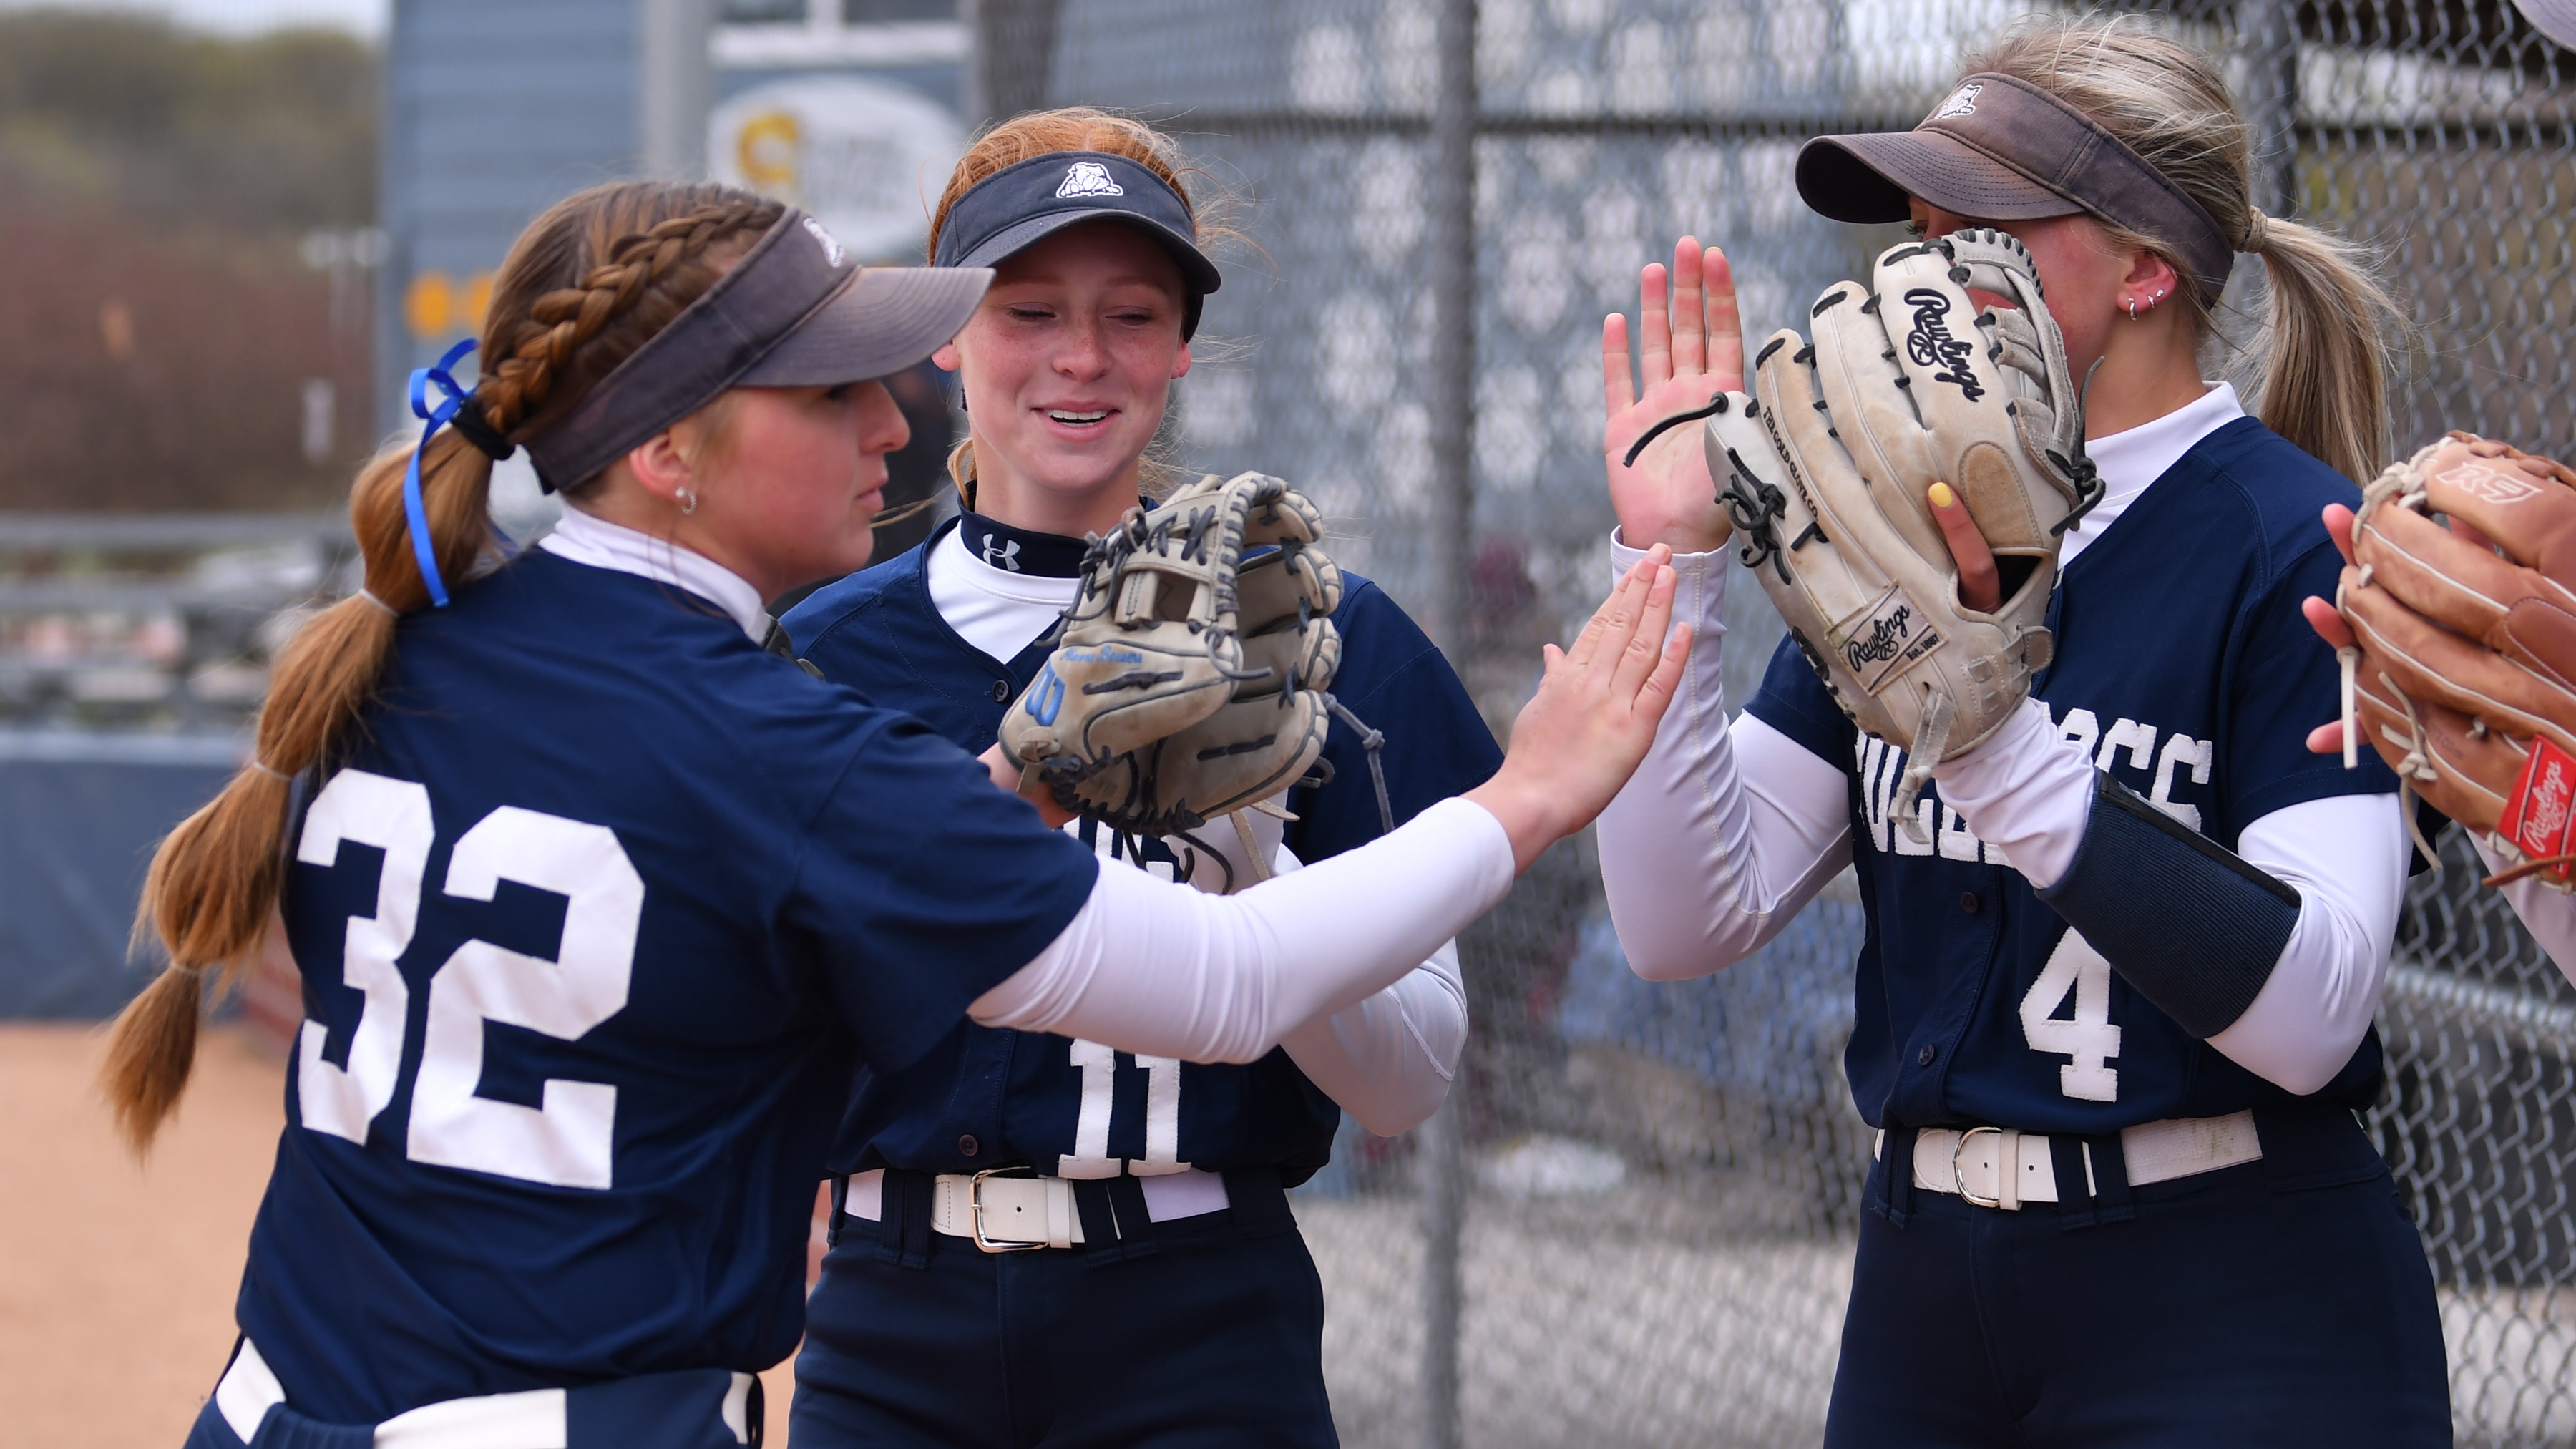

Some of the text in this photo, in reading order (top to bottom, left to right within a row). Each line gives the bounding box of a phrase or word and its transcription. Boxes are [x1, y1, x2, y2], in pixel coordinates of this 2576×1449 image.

[1904, 288, 1985, 402] Rawlings
[1763, 406, 1819, 522] THE GOLD GLOVE CO.
[2434, 461, 2544, 504] R9
[1848, 605, 1910, 672] Rawlings
[1906, 633, 1940, 660] Est. 1887
[2522, 760, 2569, 853] Rawlings
[297, 767, 645, 1191] 32
[2018, 925, 2122, 1103] 4
[1058, 1038, 1192, 1181] 11
